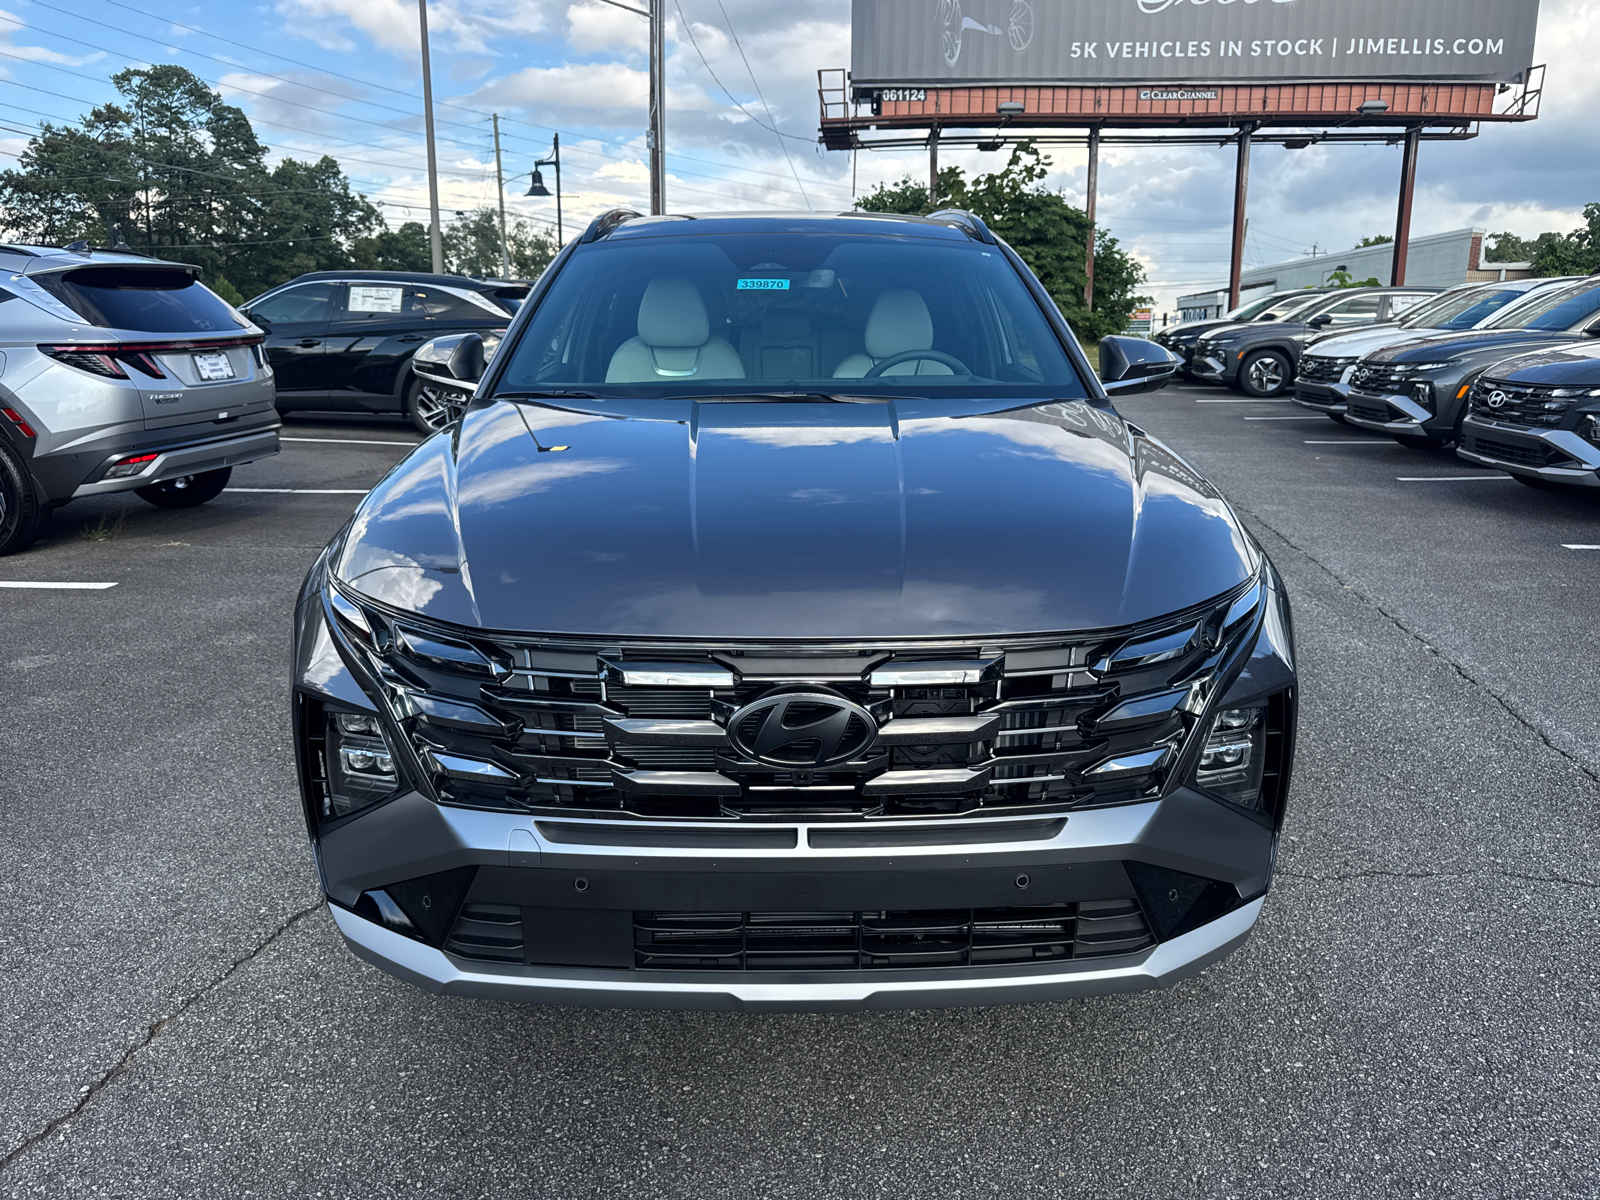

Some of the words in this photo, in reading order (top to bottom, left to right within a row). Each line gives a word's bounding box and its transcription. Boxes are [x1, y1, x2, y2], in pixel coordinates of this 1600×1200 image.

[1070, 42, 1098, 58] 5K
[1106, 40, 1211, 58] VEHICLES
[1219, 40, 1243, 57] IN
[1250, 39, 1324, 57] STOCK
[1346, 38, 1504, 55] JIMELLIS.COM
[882, 89, 926, 101] 061124
[741, 280, 784, 289] 339870
